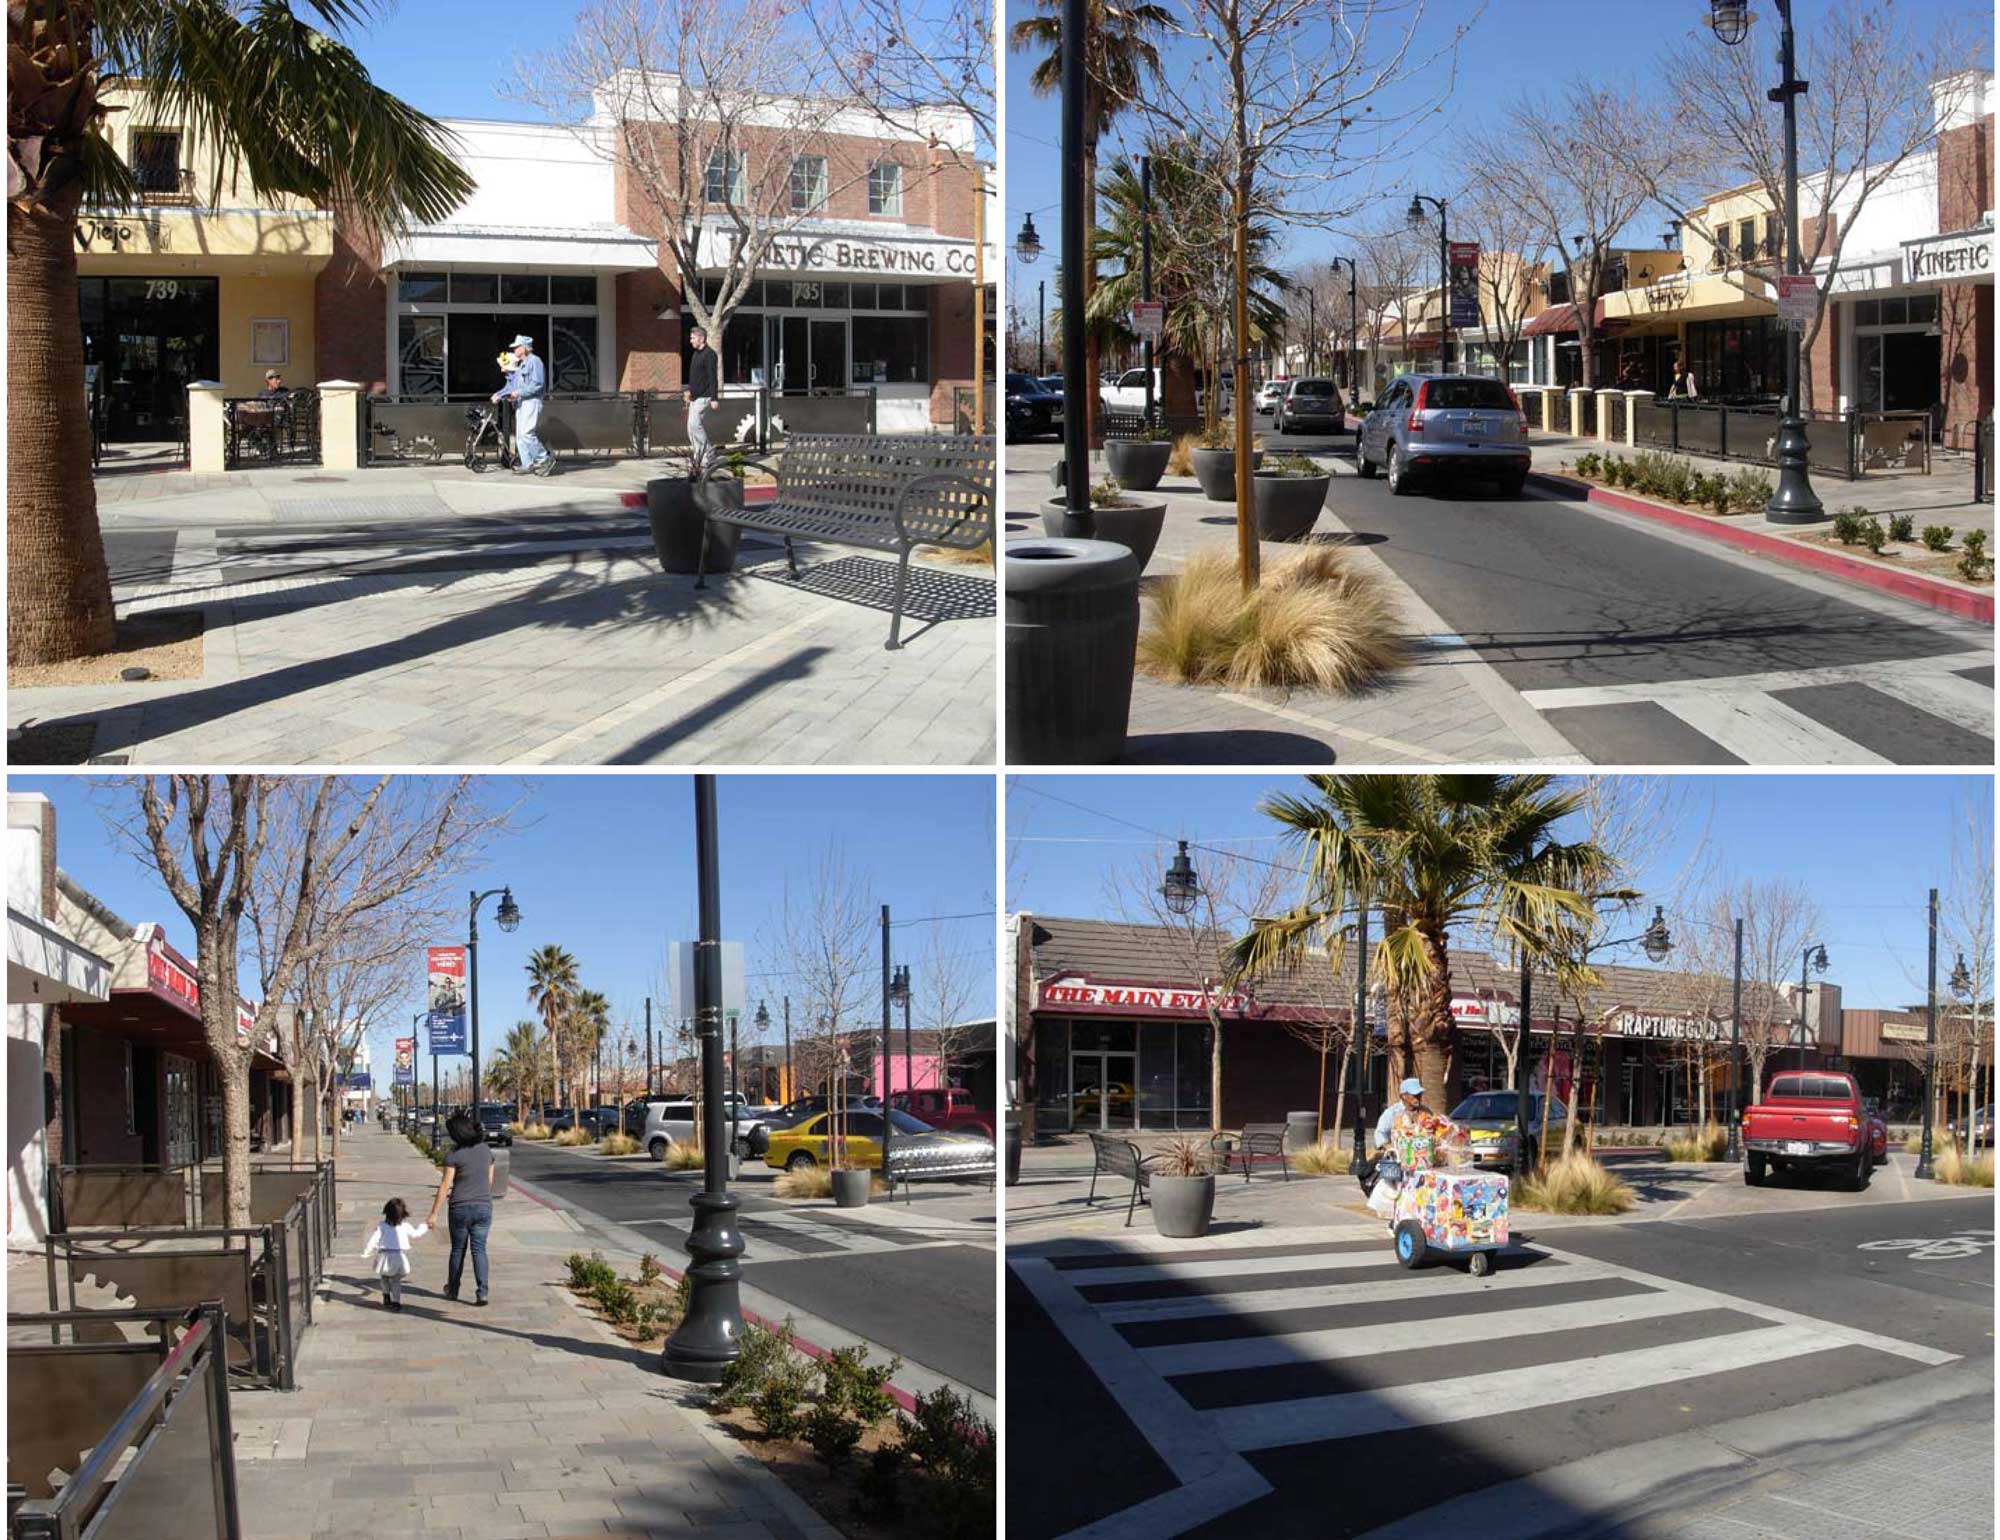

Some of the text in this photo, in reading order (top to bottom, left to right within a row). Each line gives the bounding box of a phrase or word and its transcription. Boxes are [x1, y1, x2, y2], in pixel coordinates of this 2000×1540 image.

[75, 220, 132, 252] Viejo
[729, 238, 824, 267] NETIC
[837, 244, 934, 271] BREWING
[1912, 243, 1989, 277] KINETIC
[145, 280, 177, 300] 739
[796, 282, 820, 300] 735
[1046, 986, 1096, 1003] THE
[1102, 990, 1164, 1006] MAIN
[1686, 1019, 1718, 1040] GOD
